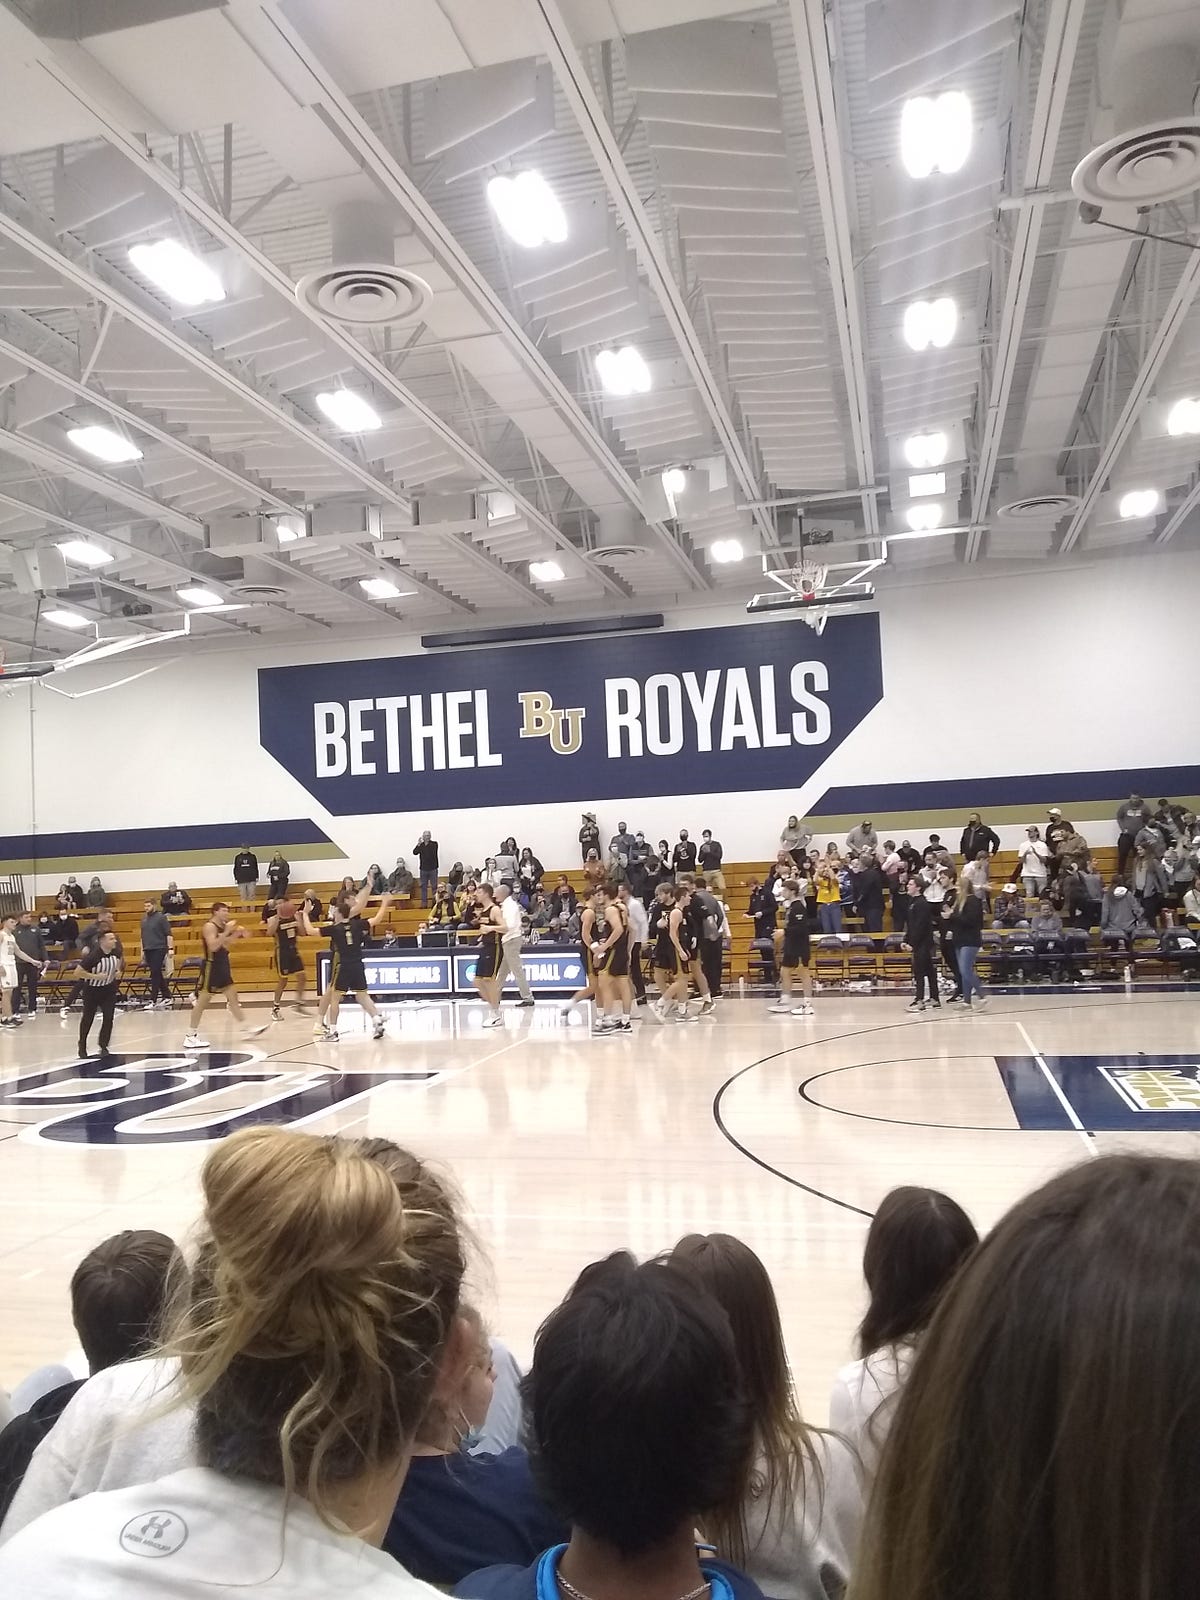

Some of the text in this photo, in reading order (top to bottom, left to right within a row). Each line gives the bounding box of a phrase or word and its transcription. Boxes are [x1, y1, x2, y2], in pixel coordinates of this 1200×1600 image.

[314, 661, 831, 779] BETHEL BU ROYALS
